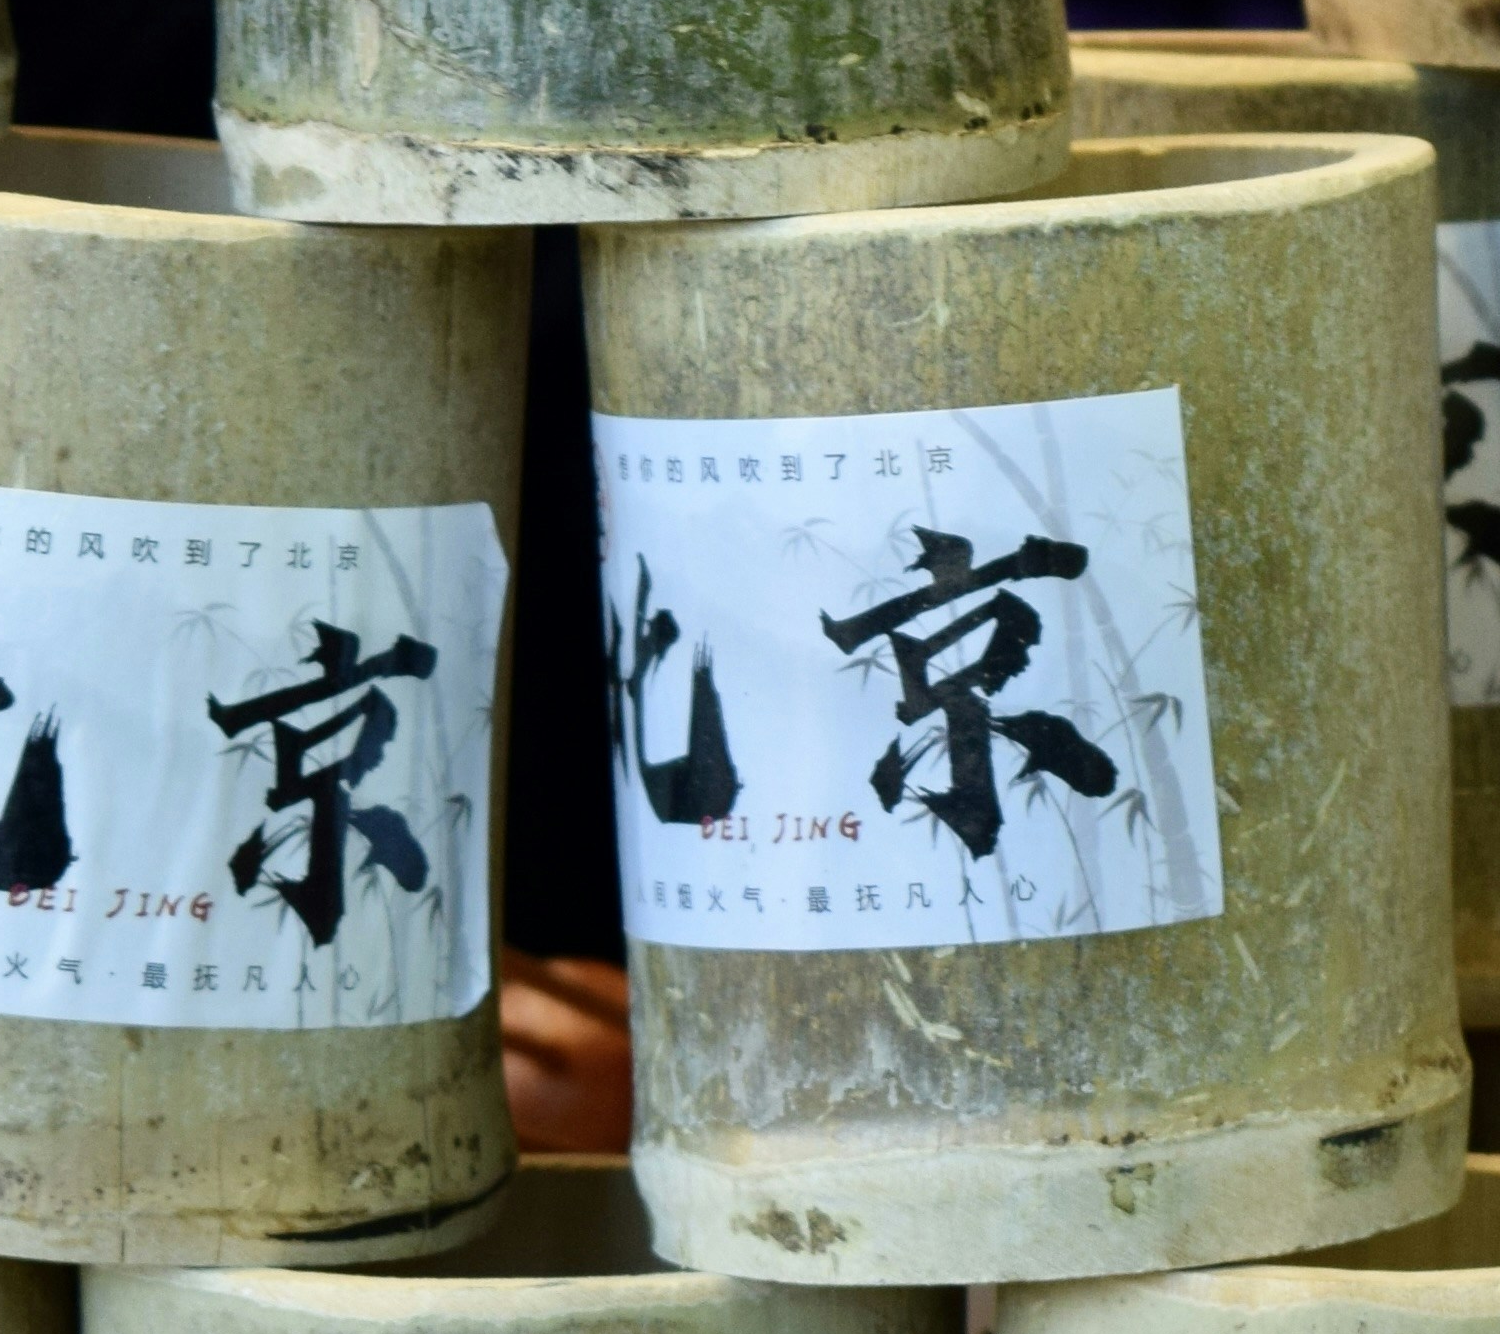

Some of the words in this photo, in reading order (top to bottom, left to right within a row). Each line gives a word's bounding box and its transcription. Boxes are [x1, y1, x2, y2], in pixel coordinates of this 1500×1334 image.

[607, 525, 1117, 860] 北京
[701, 816, 748, 840] BEI
[773, 812, 861, 841] JING
[8, 883, 76, 913] BEI
[107, 886, 214, 921] JING
